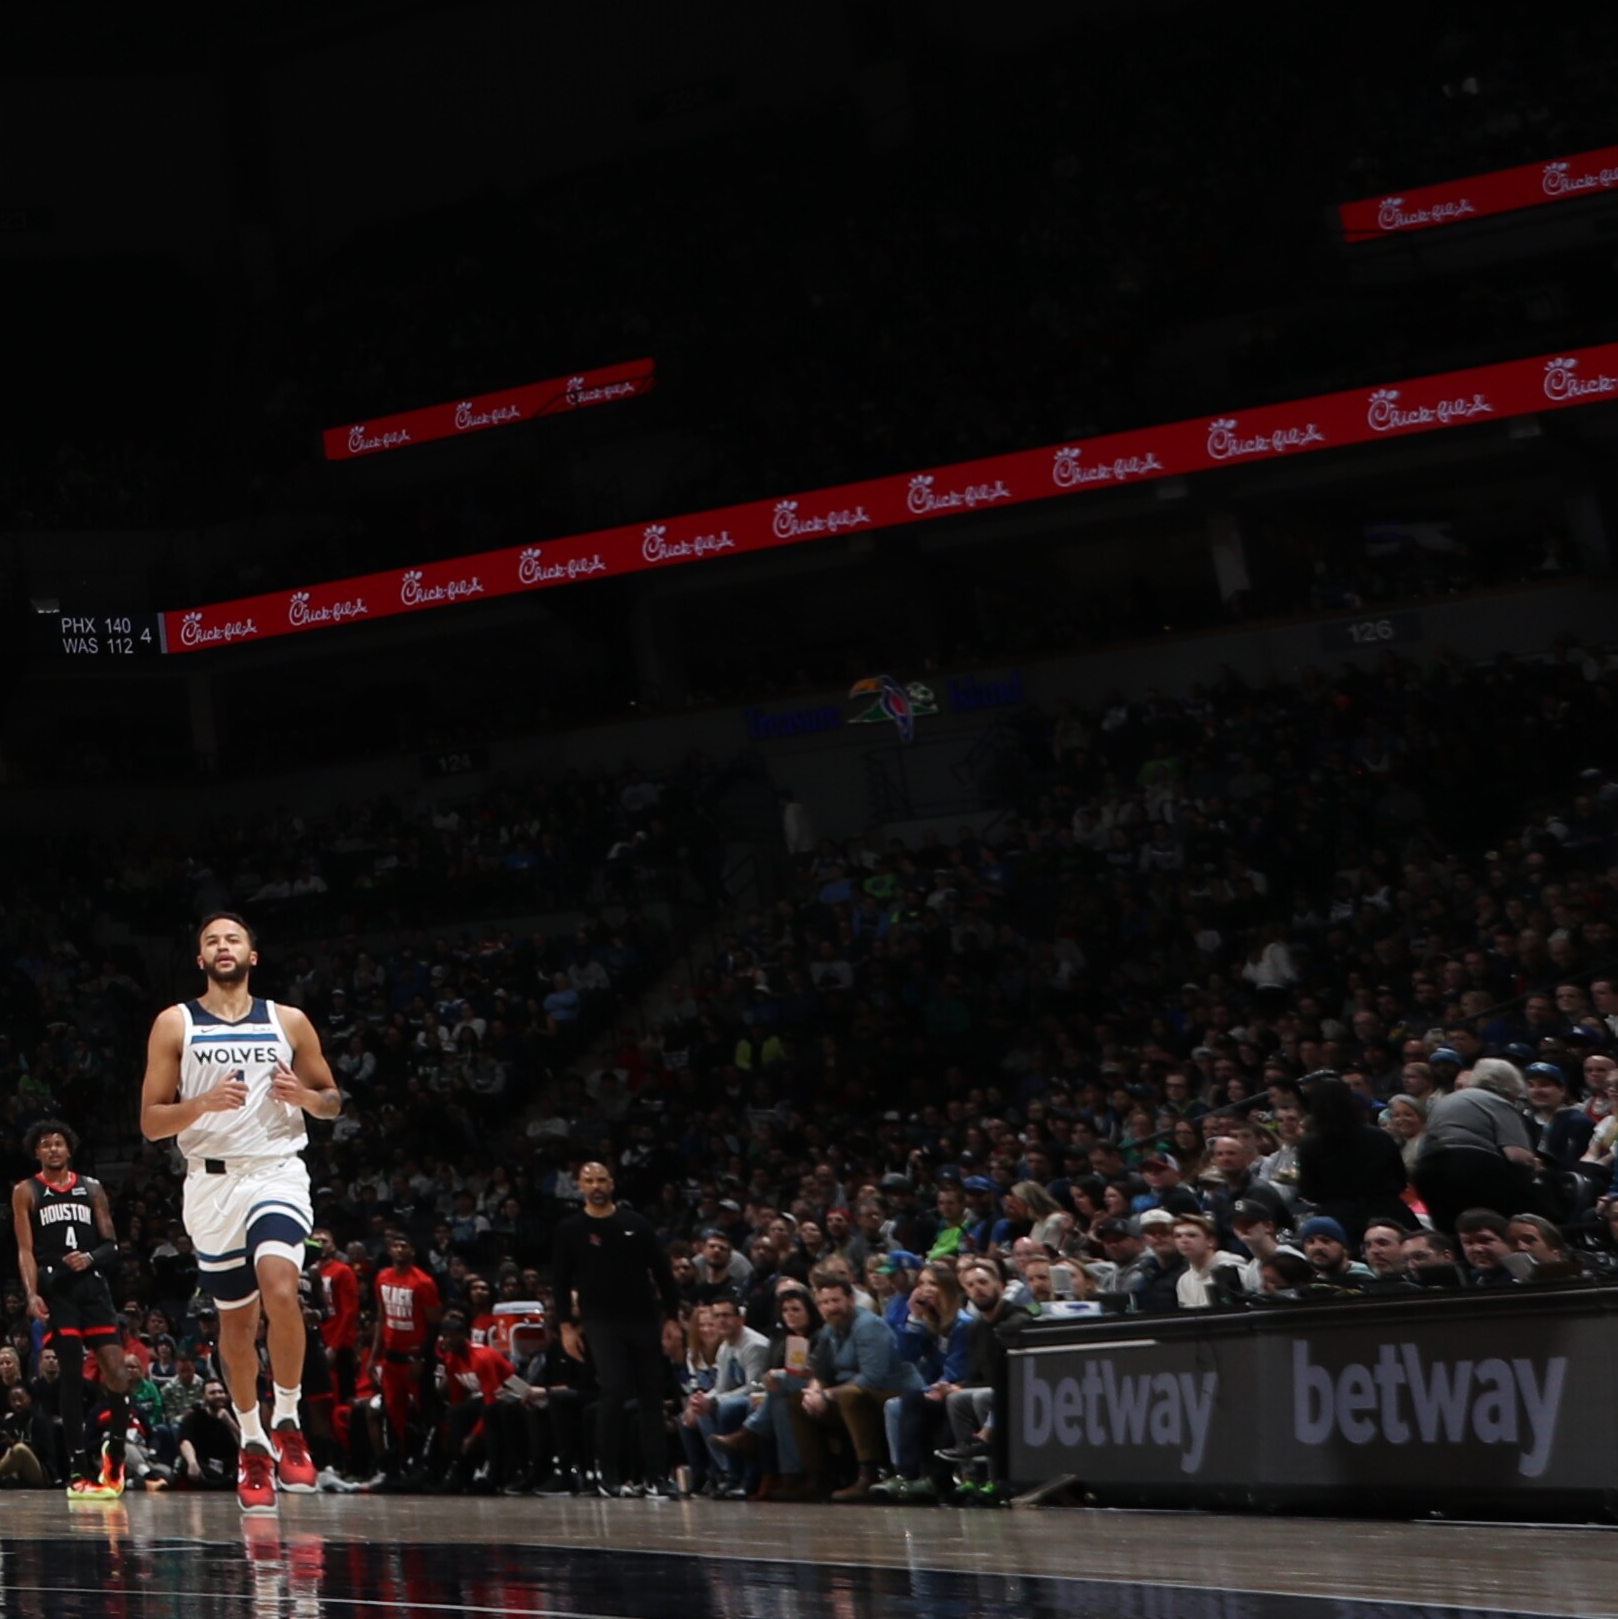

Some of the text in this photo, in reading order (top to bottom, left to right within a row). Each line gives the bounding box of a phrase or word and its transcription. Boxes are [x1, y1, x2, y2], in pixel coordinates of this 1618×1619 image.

[61, 617, 131, 633] PHX 140
[140, 628, 151, 643] 4
[1348, 620, 1395, 644] 126
[62, 638, 133, 654] WAS 112
[194, 1048, 278, 1064] WOLVES
[39, 1203, 91, 1226] HOUSTON
[65, 1226, 77, 1249] 4
[1023, 1356, 1218, 1473] betway
[1293, 1338, 1567, 1478] betway
